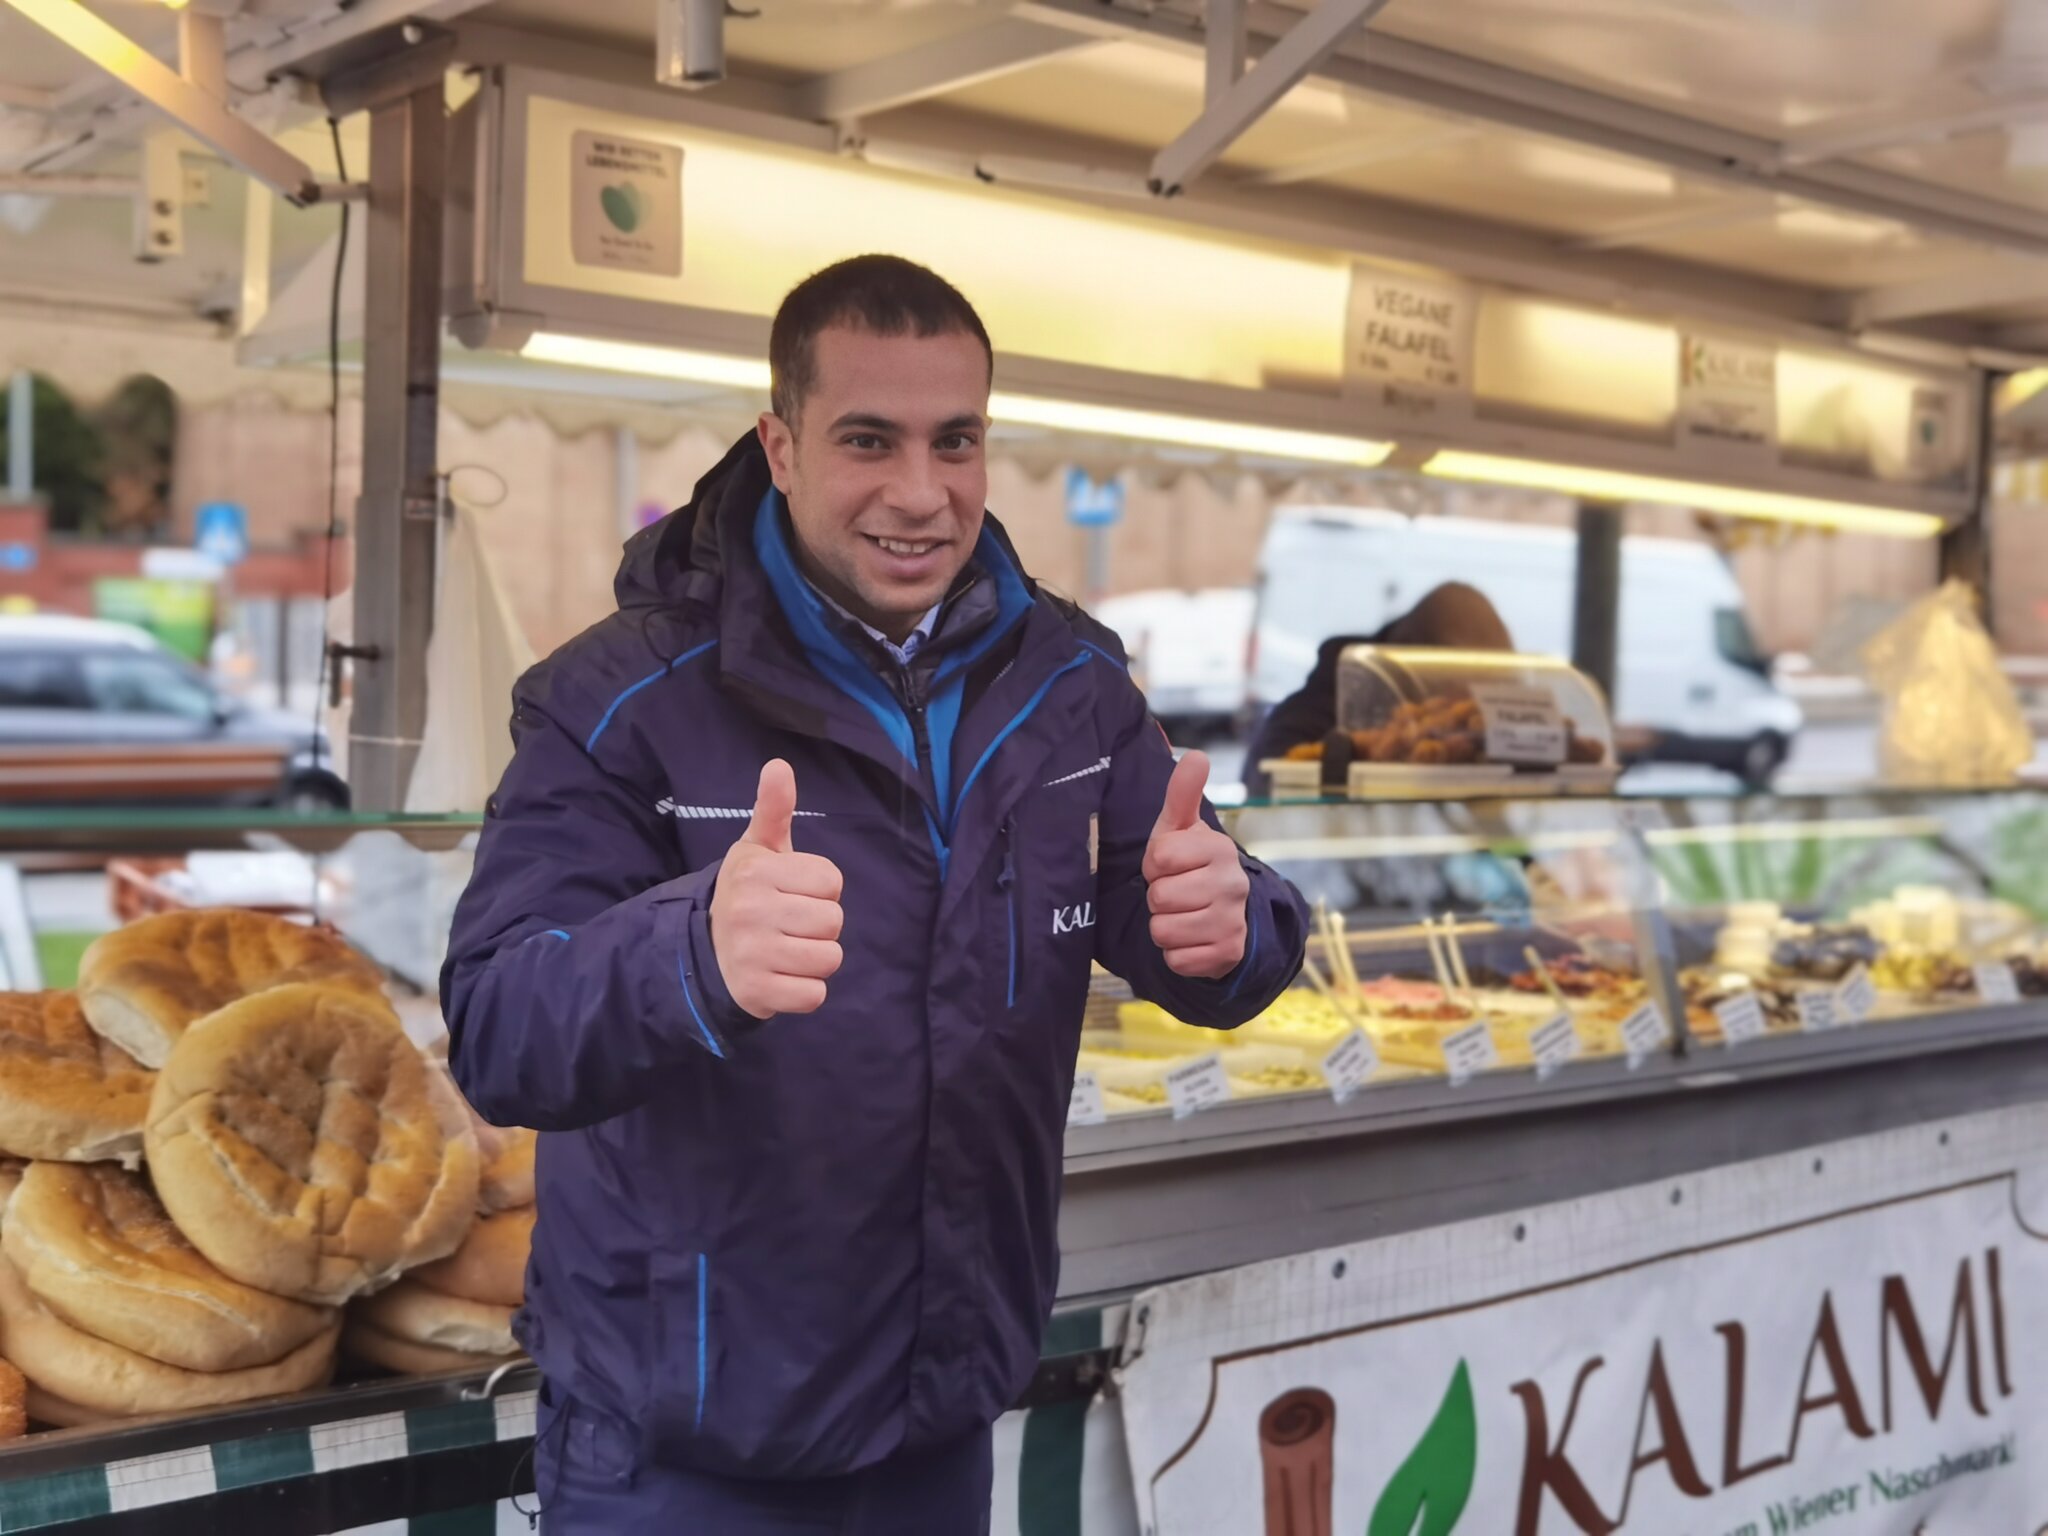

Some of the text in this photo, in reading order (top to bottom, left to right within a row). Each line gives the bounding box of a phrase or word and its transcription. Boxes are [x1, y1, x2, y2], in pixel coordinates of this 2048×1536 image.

[1373, 283, 1453, 328] VEGANE
[1365, 320, 1453, 362] FALAFEL
[1053, 901, 1096, 935] KAL
[1509, 1246, 2012, 1536] KALAMI
[1765, 1484, 1859, 1536] Wiener
